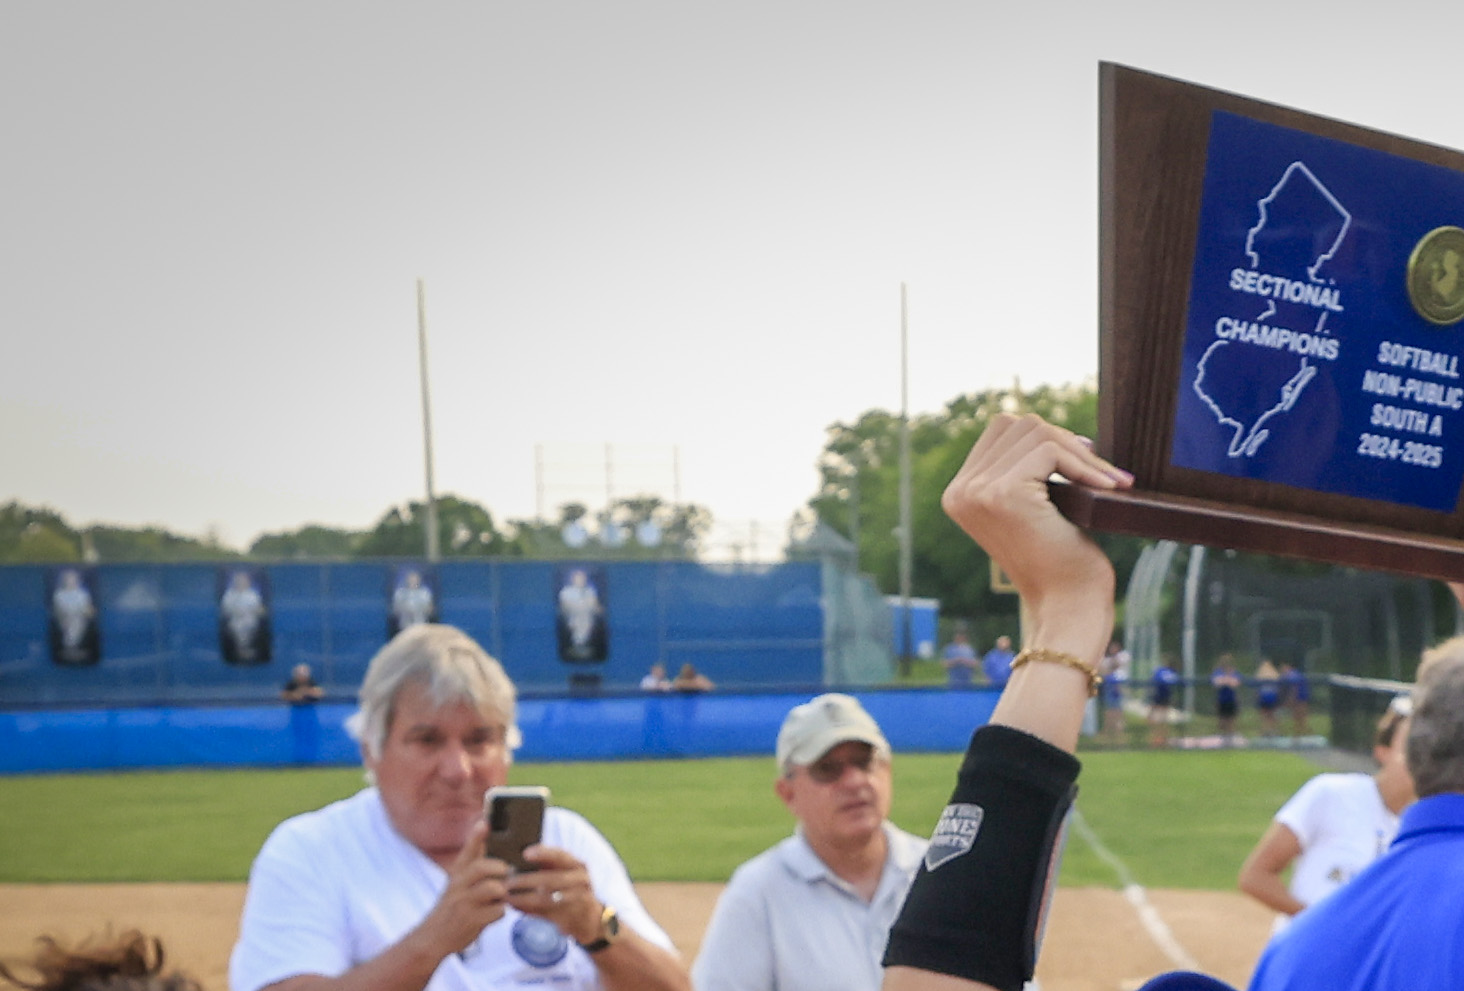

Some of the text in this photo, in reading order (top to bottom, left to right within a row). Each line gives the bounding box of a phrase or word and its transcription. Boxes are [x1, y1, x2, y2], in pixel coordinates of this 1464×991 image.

[1229, 268, 1343, 311] SECTIONAL
[1216, 317, 1340, 360] CHAMPIONS
[1378, 341, 1459, 377] SOFTBALL
[1363, 371, 1463, 409] NON-PUBLIC
[1370, 404, 1443, 437] SOUTH A
[1358, 433, 1443, 467] 2024-2025
